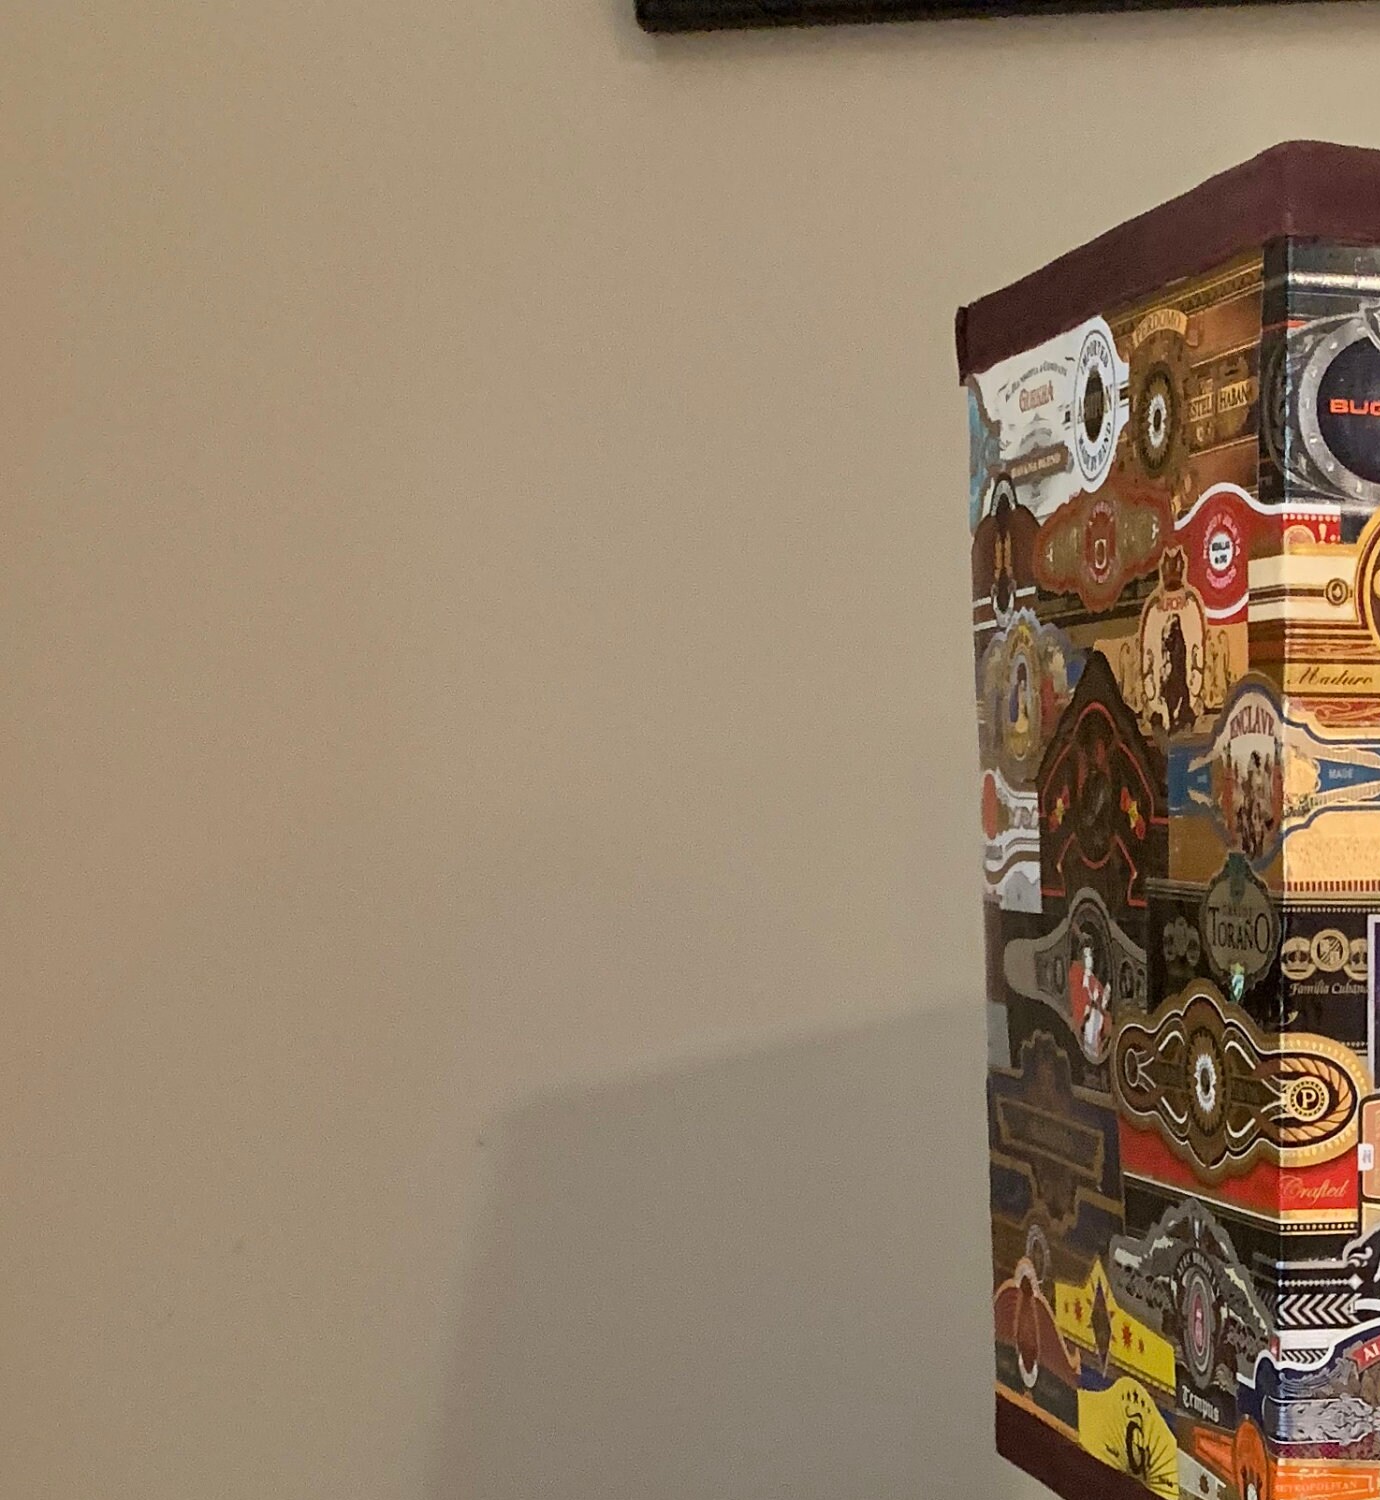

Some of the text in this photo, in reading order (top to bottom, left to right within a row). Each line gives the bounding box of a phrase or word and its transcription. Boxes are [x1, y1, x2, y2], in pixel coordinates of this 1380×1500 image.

[1286, 664, 1374, 689] Maduro
[1229, 705, 1275, 740] ENCLAVE
[1301, 1089, 1317, 1109] P
[1281, 1174, 1349, 1200] Crafted
